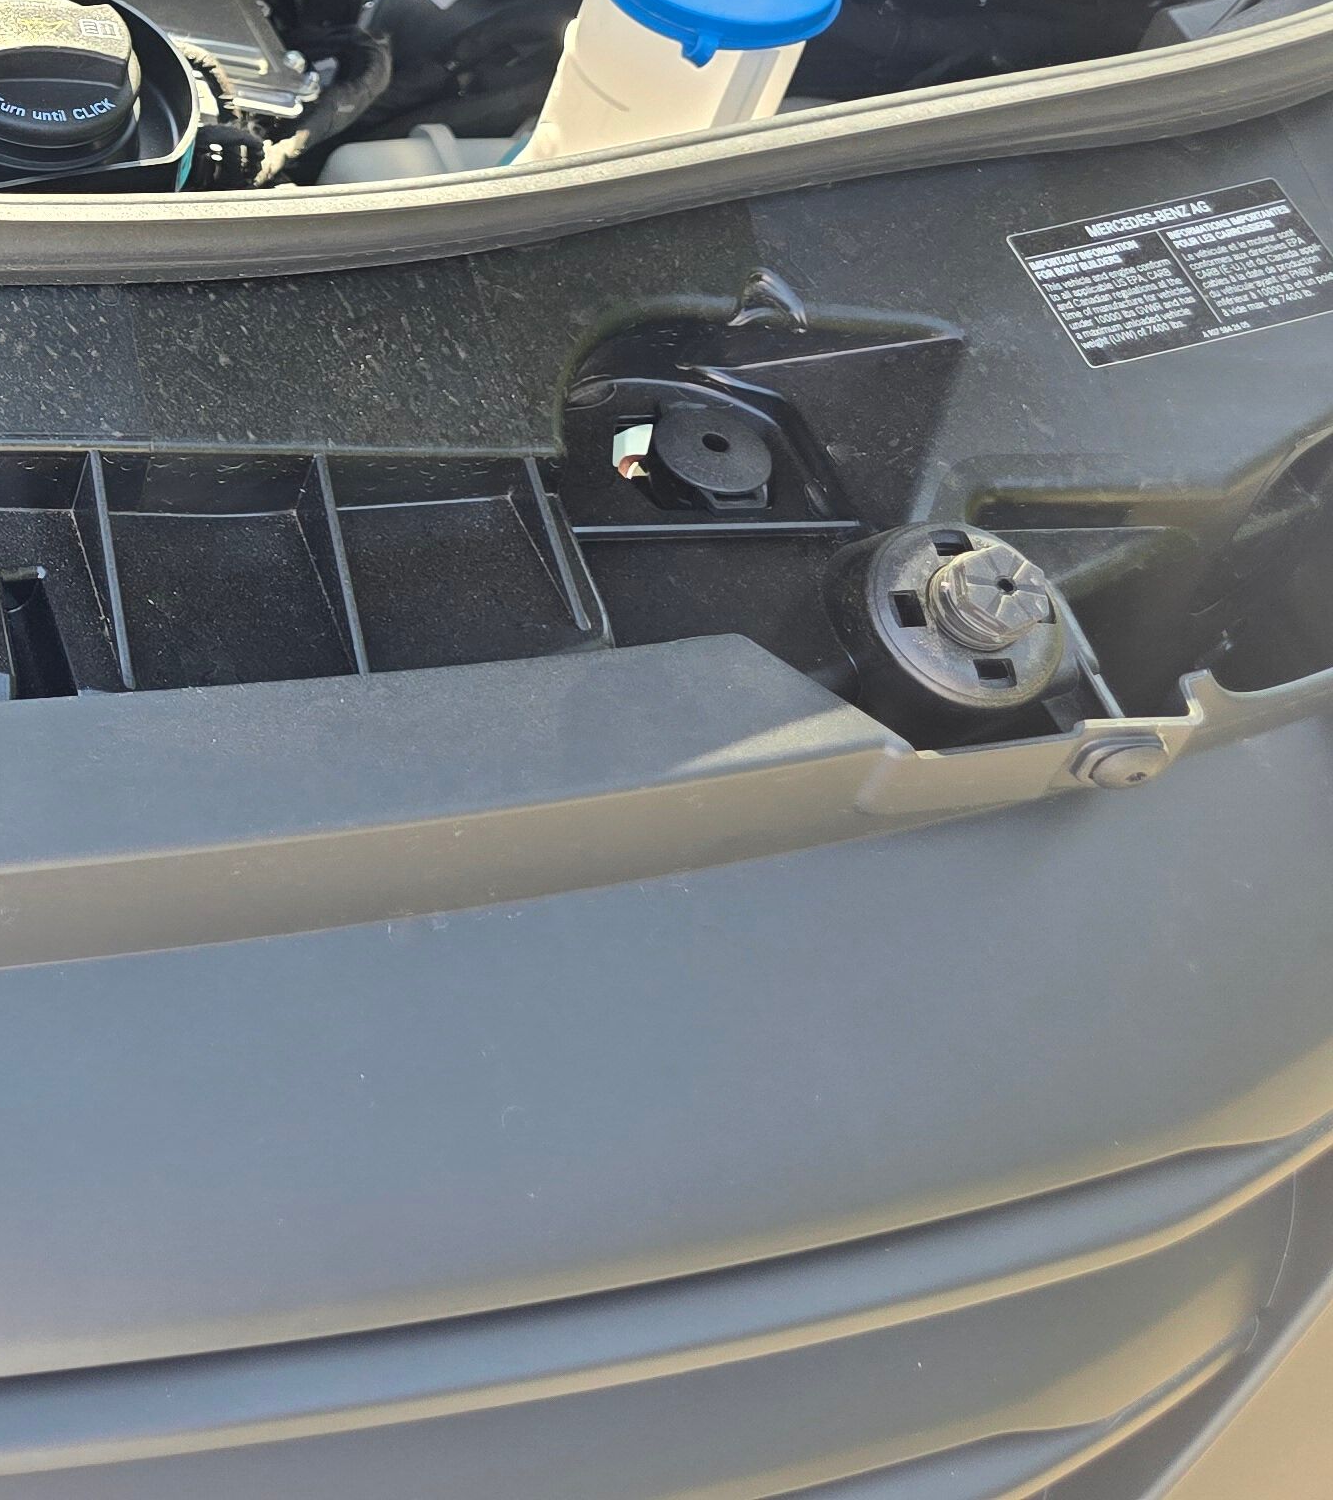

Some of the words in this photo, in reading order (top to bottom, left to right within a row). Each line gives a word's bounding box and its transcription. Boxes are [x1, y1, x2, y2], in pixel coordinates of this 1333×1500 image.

[32, 110, 67, 122] until
[72, 98, 117, 120] CLICK
[1085, 205, 1191, 237] MERCEDES-BENZ
[1190, 201, 1212, 214] AG
[1166, 219, 1232, 240] INFORMATIONS
[1229, 205, 1291, 225] IMPORTANTES
[1028, 253, 1079, 270] IMPORTANT
[1078, 240, 1139, 260] INFORMATION
[1173, 237, 1200, 249] POUR
[1197, 233, 1216, 243] LES
[1181, 253, 1195, 261] Le
[1194, 246, 1229, 258] véhicule
[1228, 242, 1238, 250] et
[1246, 234, 1277, 246] moteur
[1276, 228, 1297, 239] sont
[1189, 256, 1233, 270] conformes
[1232, 252, 1249, 260] aux
[1248, 242, 1288, 256] directives
[1034, 269, 1056, 280] FOR
[1053, 264, 1080, 276] BODY
[1078, 255, 1123, 270] BUILDERS
[1042, 282, 1063, 291] This
[1061, 276, 1092, 288] vehicle
[1092, 272, 1109, 282] and
[1108, 267, 1137, 280] engine
[1136, 259, 1171, 271] conform
[1195, 267, 1220, 279] CARB
[1246, 259, 1257, 268] et
[1256, 257, 1268, 265] du
[1266, 250, 1300, 262] Canada
[1202, 278, 1230, 289] cables
[1245, 269, 1265, 278] date
[1265, 266, 1277, 274] de
[1275, 255, 1321, 272] production
[1049, 294, 1061, 302] to
[1061, 290, 1073, 299] all
[1072, 282, 1114, 297] applicable
[1112, 278, 1127, 287] US
[1057, 301, 1074, 311] and
[1073, 294, 1113, 307] Canadian
[1112, 283, 1158, 299] regulations
[1157, 280, 1168, 288] at
[1166, 278, 1183, 286] the
[1209, 290, 1221, 298] du
[1220, 282, 1256, 295] véhicule
[1254, 275, 1279, 288] ayant
[1288, 266, 1314, 278] PNBV
[1214, 294, 1250, 307] inférieur
[1257, 285, 1285, 297] 10000
[1293, 280, 1305, 288] et
[1303, 278, 1317, 286] un
[1061, 311, 1083, 320] time
[1083, 307, 1093, 316] of
[1092, 297, 1145, 314] manufacture
[1143, 294, 1157, 302] for
[1157, 286, 1192, 299] vehicles
[1069, 319, 1094, 330] under
[1094, 312, 1122, 324] 10000
[1121, 310, 1137, 318] lbs
[1135, 302, 1163, 314] GVWR
[1163, 298, 1180, 308] and
[1178, 296, 1196, 305] has
[1228, 306, 1248, 314] vide
[1268, 297, 1281, 305] de
[1278, 291, 1303, 302] 7400
[1081, 336, 1110, 349] weight
[1109, 330, 1138, 344] (UVW)
[1137, 327, 1148, 337] of
[1146, 322, 1170, 334] 7400
[1082, 324, 1123, 338] maximum
[1122, 314, 1162, 329] unloaded
[1160, 308, 1192, 320] vehicle
